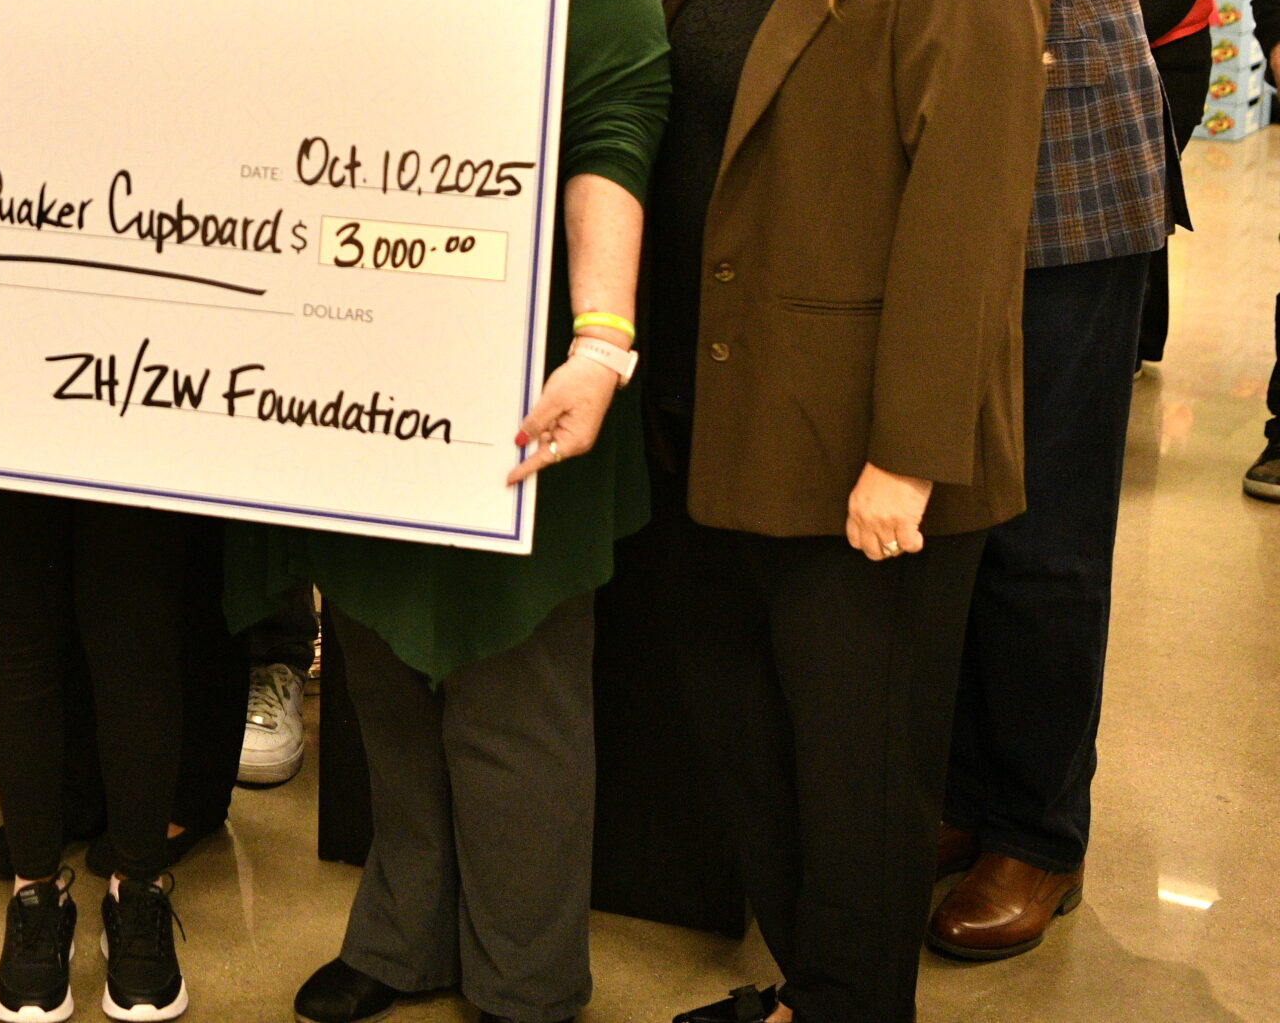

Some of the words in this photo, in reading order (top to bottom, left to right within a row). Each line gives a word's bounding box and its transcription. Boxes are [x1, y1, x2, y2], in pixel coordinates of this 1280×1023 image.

[296, 136, 368, 189] Oct.
[108, 169, 284, 254] Cupboard
[290, 219, 309, 254] $
[302, 303, 375, 324] DOLLARS
[43, 337, 211, 418] ZH/ZW
[220, 363, 454, 445] Foundation
